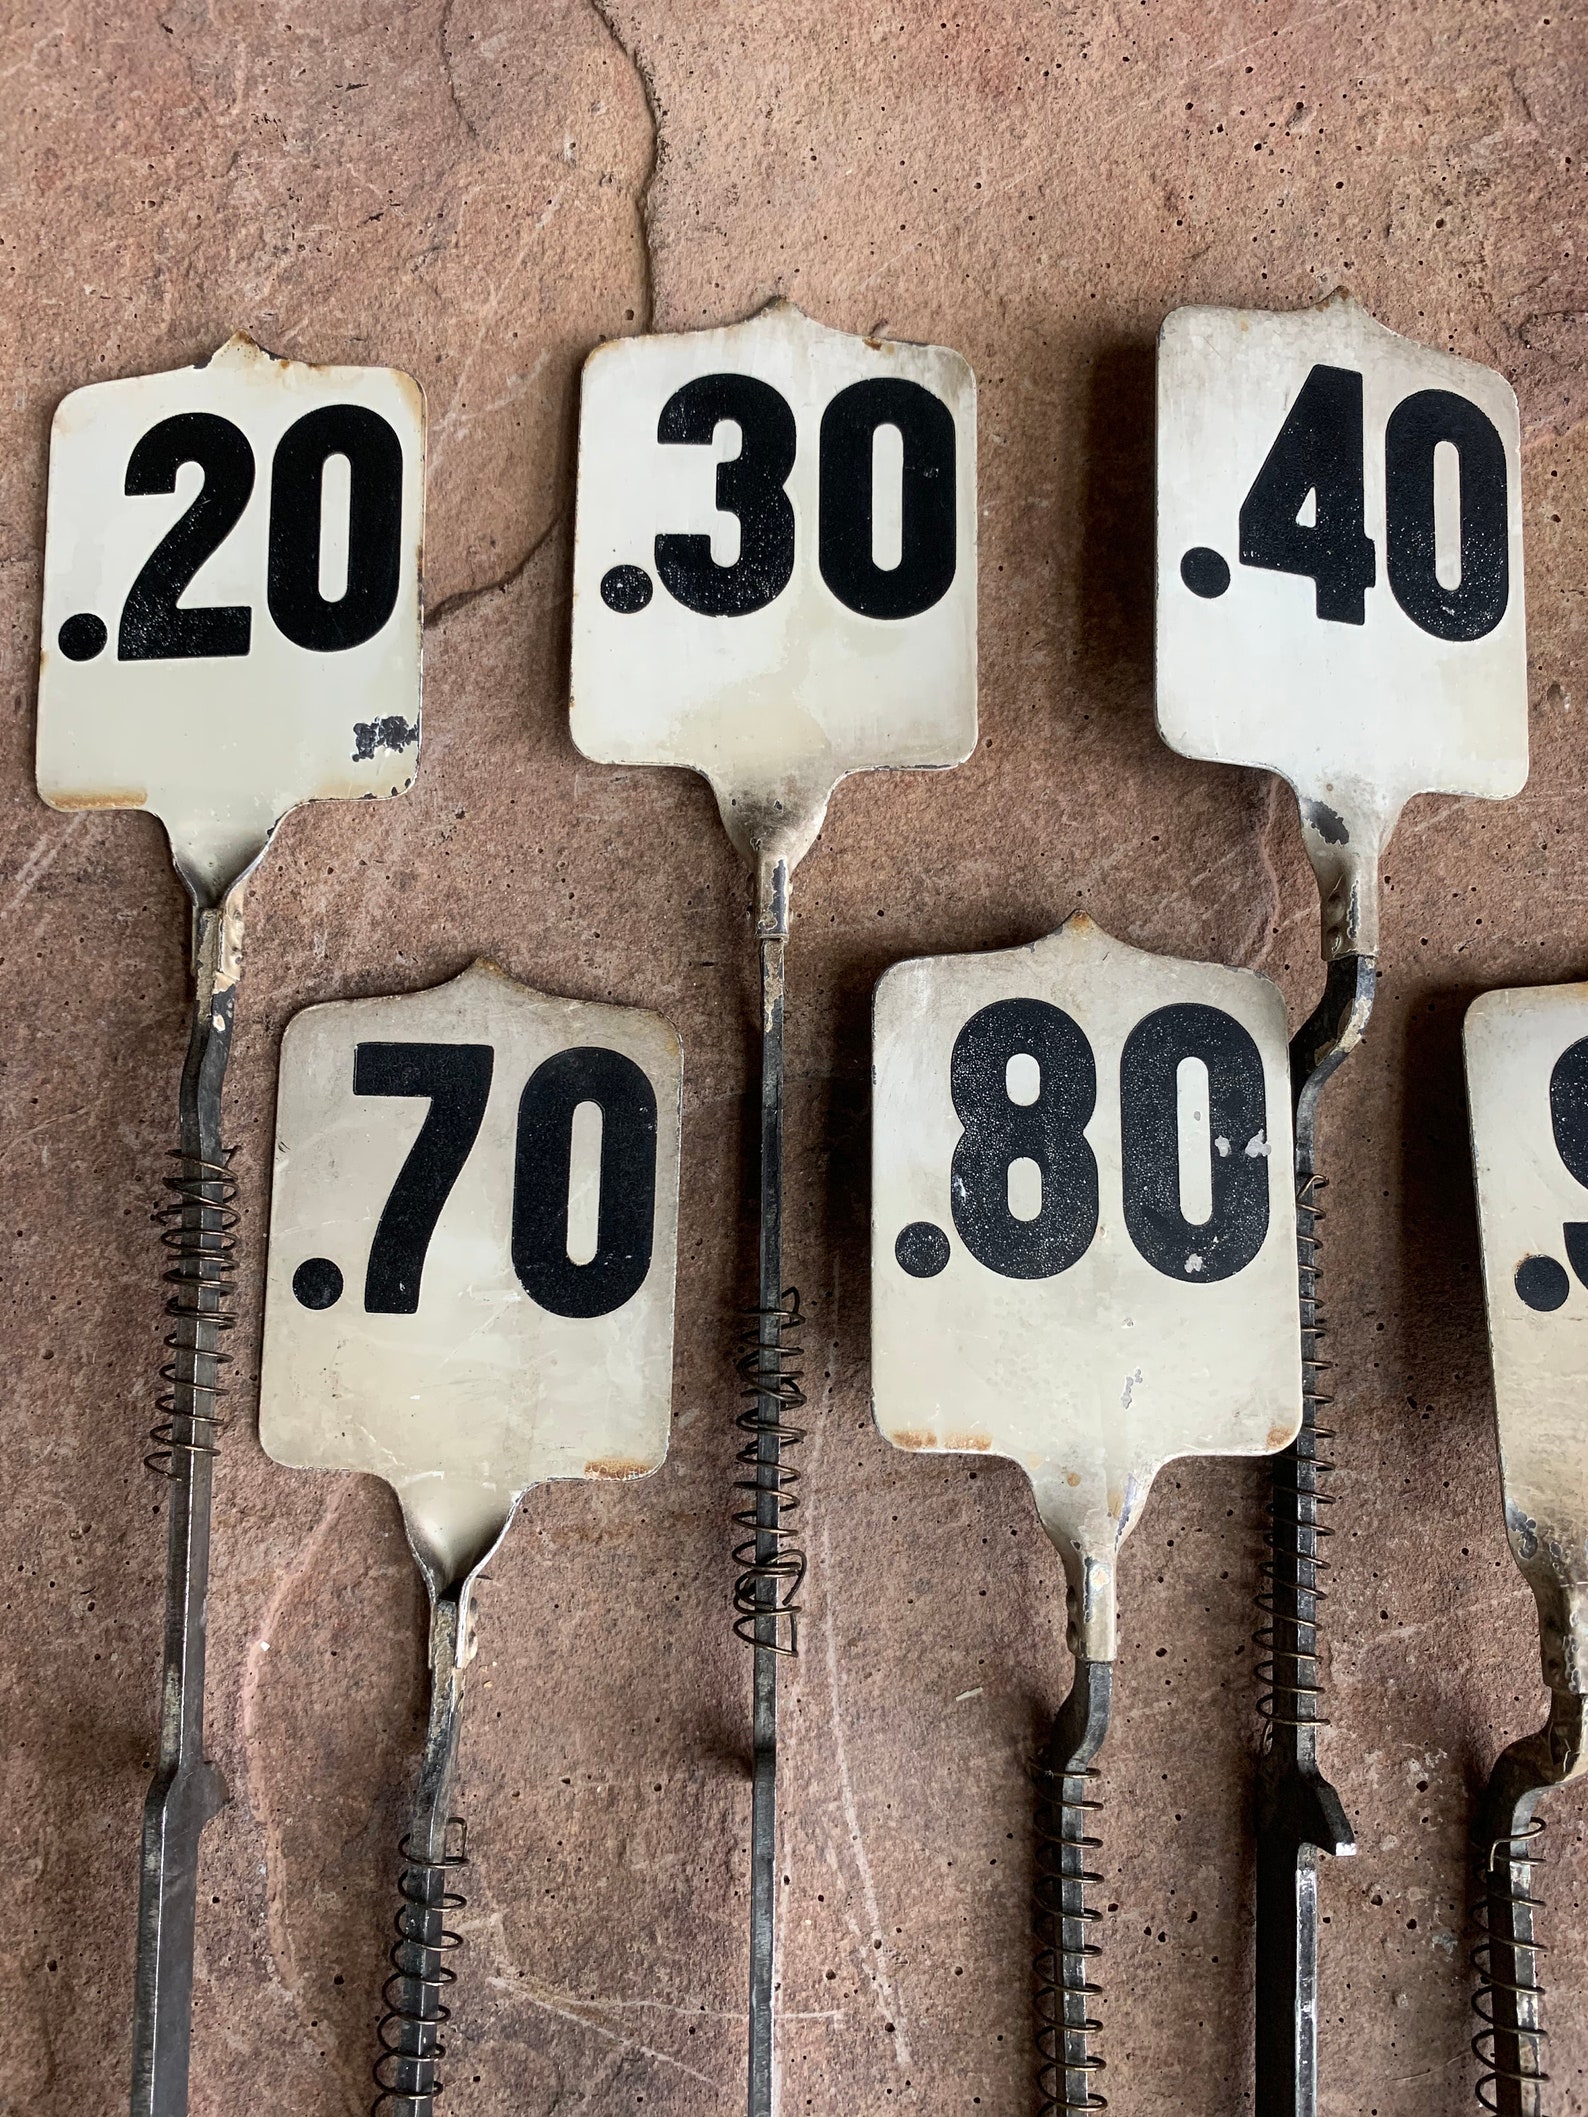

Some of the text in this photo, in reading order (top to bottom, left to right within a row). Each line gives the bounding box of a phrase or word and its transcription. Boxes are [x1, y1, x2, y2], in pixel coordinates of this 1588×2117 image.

[58, 403, 403, 662] .20
[600, 373, 957, 621] .30
[1180, 363, 1510, 642] .40
[292, 1041, 658, 1319] .70
[894, 997, 1270, 1284] .80
